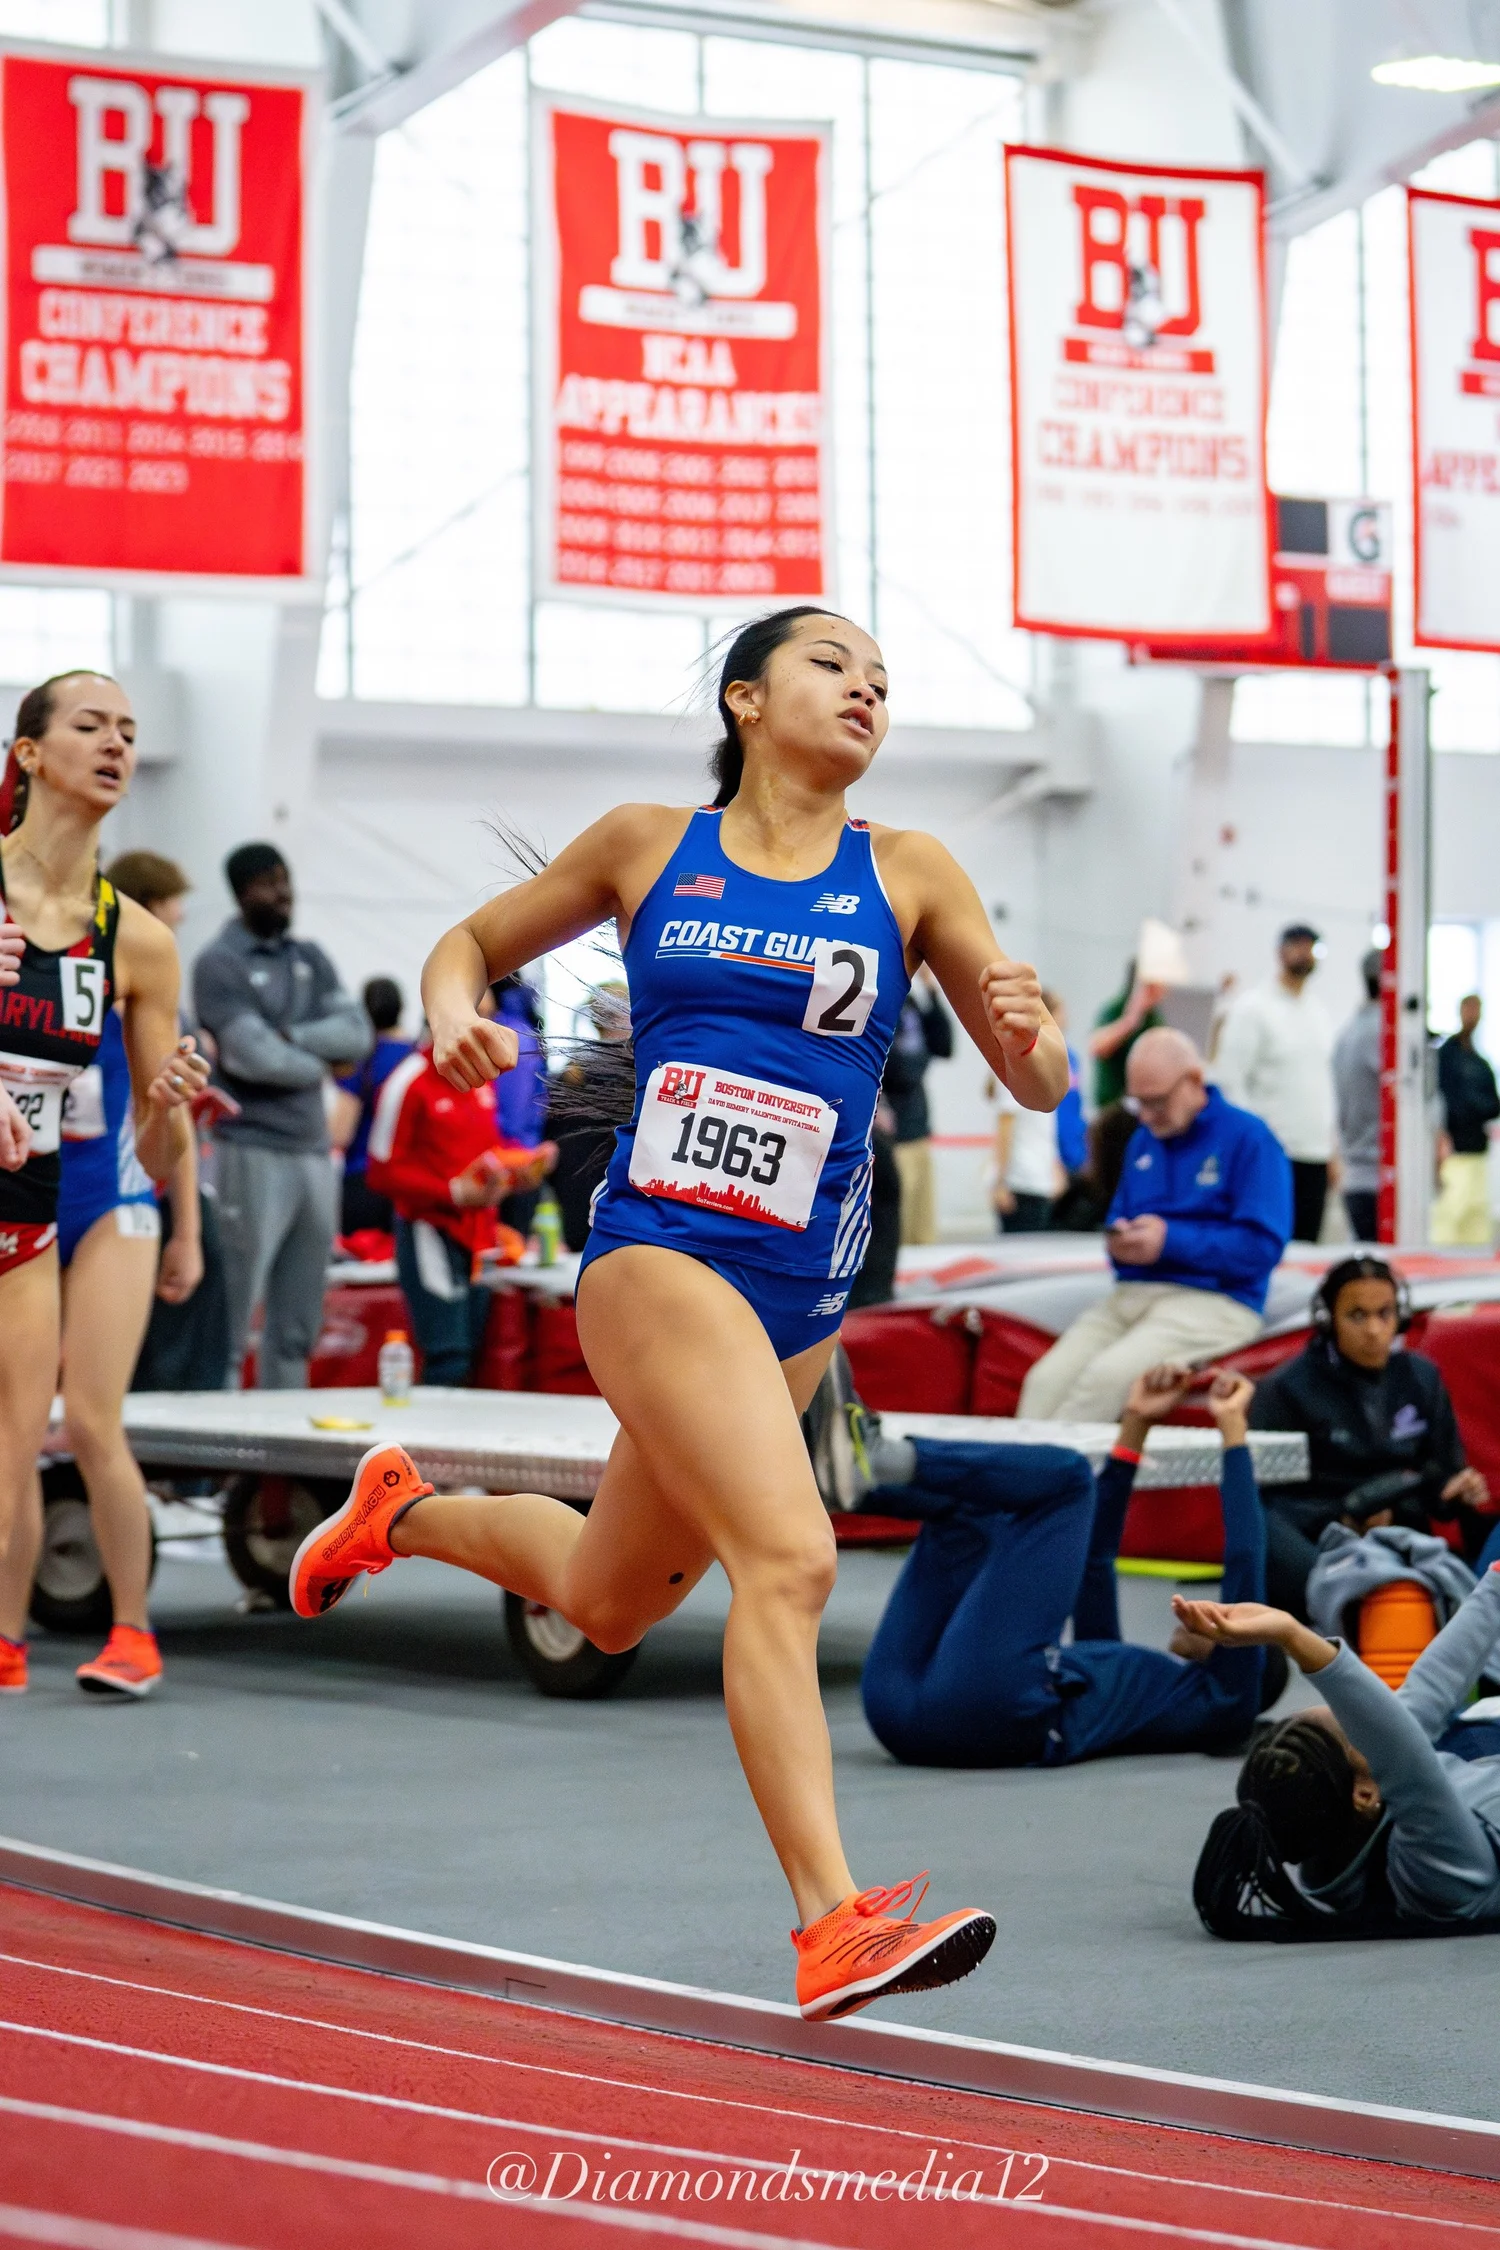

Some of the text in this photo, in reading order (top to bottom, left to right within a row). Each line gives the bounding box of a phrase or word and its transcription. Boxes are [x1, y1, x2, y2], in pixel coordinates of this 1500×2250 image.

[67, 74, 250, 256] BU
[608, 128, 774, 298] BU
[1073, 184, 1205, 336] BU
[20, 338, 291, 421] CHAMPIONS
[642, 334, 738, 388] NCAA
[1040, 417, 1248, 480] CHAMPIONS
[659, 921, 832, 962] COAST GUA
[75, 964, 95, 1026] 5
[817, 949, 865, 1031] 2
[658, 1066, 706, 1101] BU
[708, 1097, 725, 1108] DAVID
[750, 1108, 782, 1122] VALENTINE
[782, 1116, 820, 1133] INVITATIONAL
[714, 1081, 822, 1119] BOSTON UNIVERSITY
[671, 1112, 787, 1186] 1963
